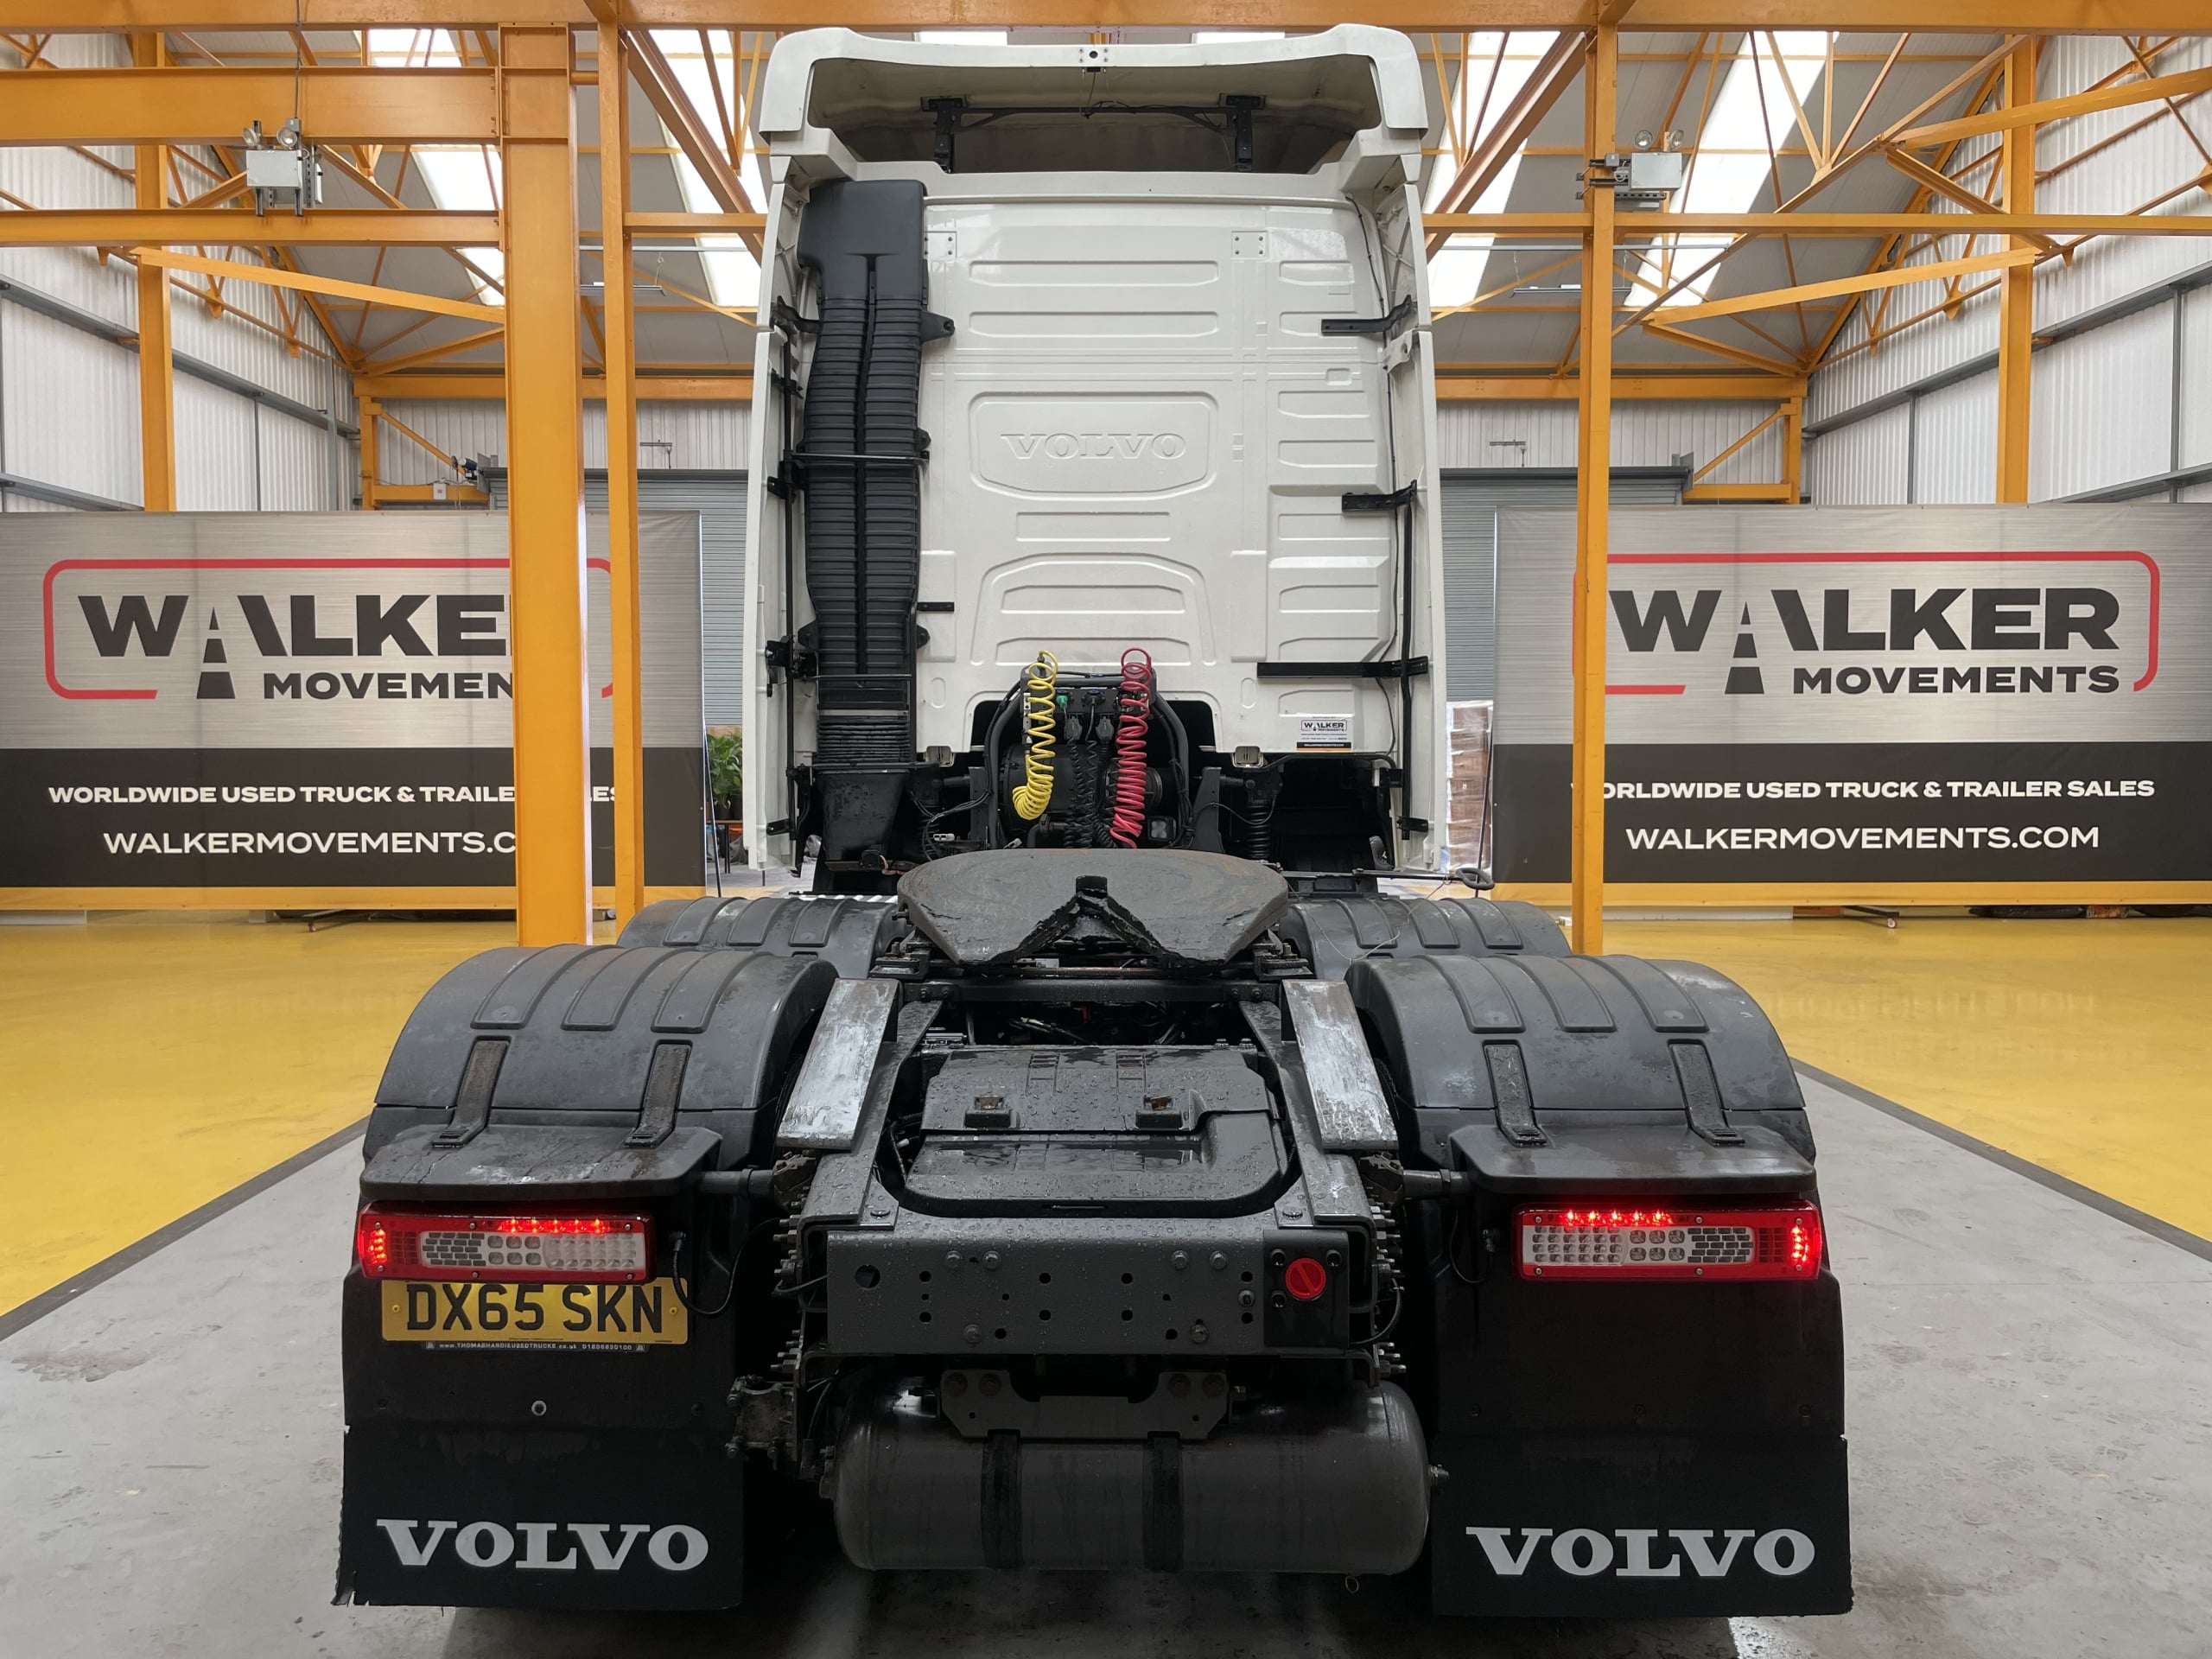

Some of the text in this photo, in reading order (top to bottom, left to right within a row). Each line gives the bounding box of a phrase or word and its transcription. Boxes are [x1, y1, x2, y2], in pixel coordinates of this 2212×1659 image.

[1000, 433, 1187, 460] VOLVO
[77, 594, 512, 700] WALKE
[1609, 588, 2120, 695] WALKER
[264, 671, 513, 700] MOVEMEN
[1792, 665, 2120, 694] MOVEMENTS
[1304, 722, 1344, 731] WALKER
[48, 785, 516, 804] WORLDWIDE USED TRUCK & TRAILE
[1571, 779, 2156, 799] ORLDWIDE USED TRUCK & TRAILER SALES
[104, 831, 517, 855] WALKERMOVEMENTS.C
[1625, 826, 2100, 850] WALKERMOVEMENTS.COM
[406, 1283, 663, 1334] DX65 SKN
[377, 1518, 709, 1571] VOLVO
[1465, 1526, 1815, 1578] VOLVO
